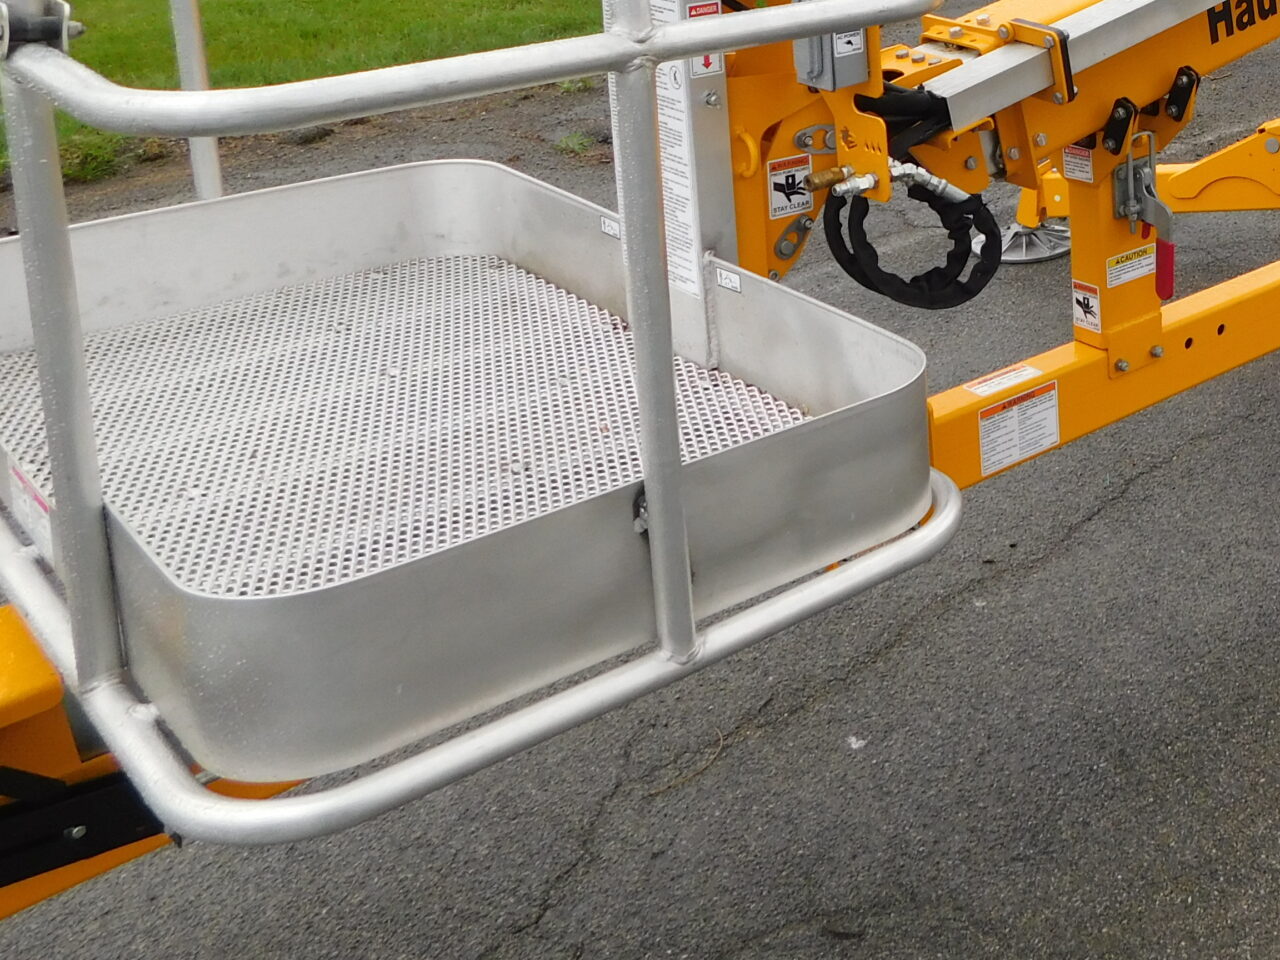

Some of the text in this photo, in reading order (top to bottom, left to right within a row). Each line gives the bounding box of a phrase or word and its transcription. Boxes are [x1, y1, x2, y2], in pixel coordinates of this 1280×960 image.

[696, 5, 718, 14] DANGER
[773, 200, 810, 213] STAY CLEAR
[1120, 248, 1148, 264] CAUTION
